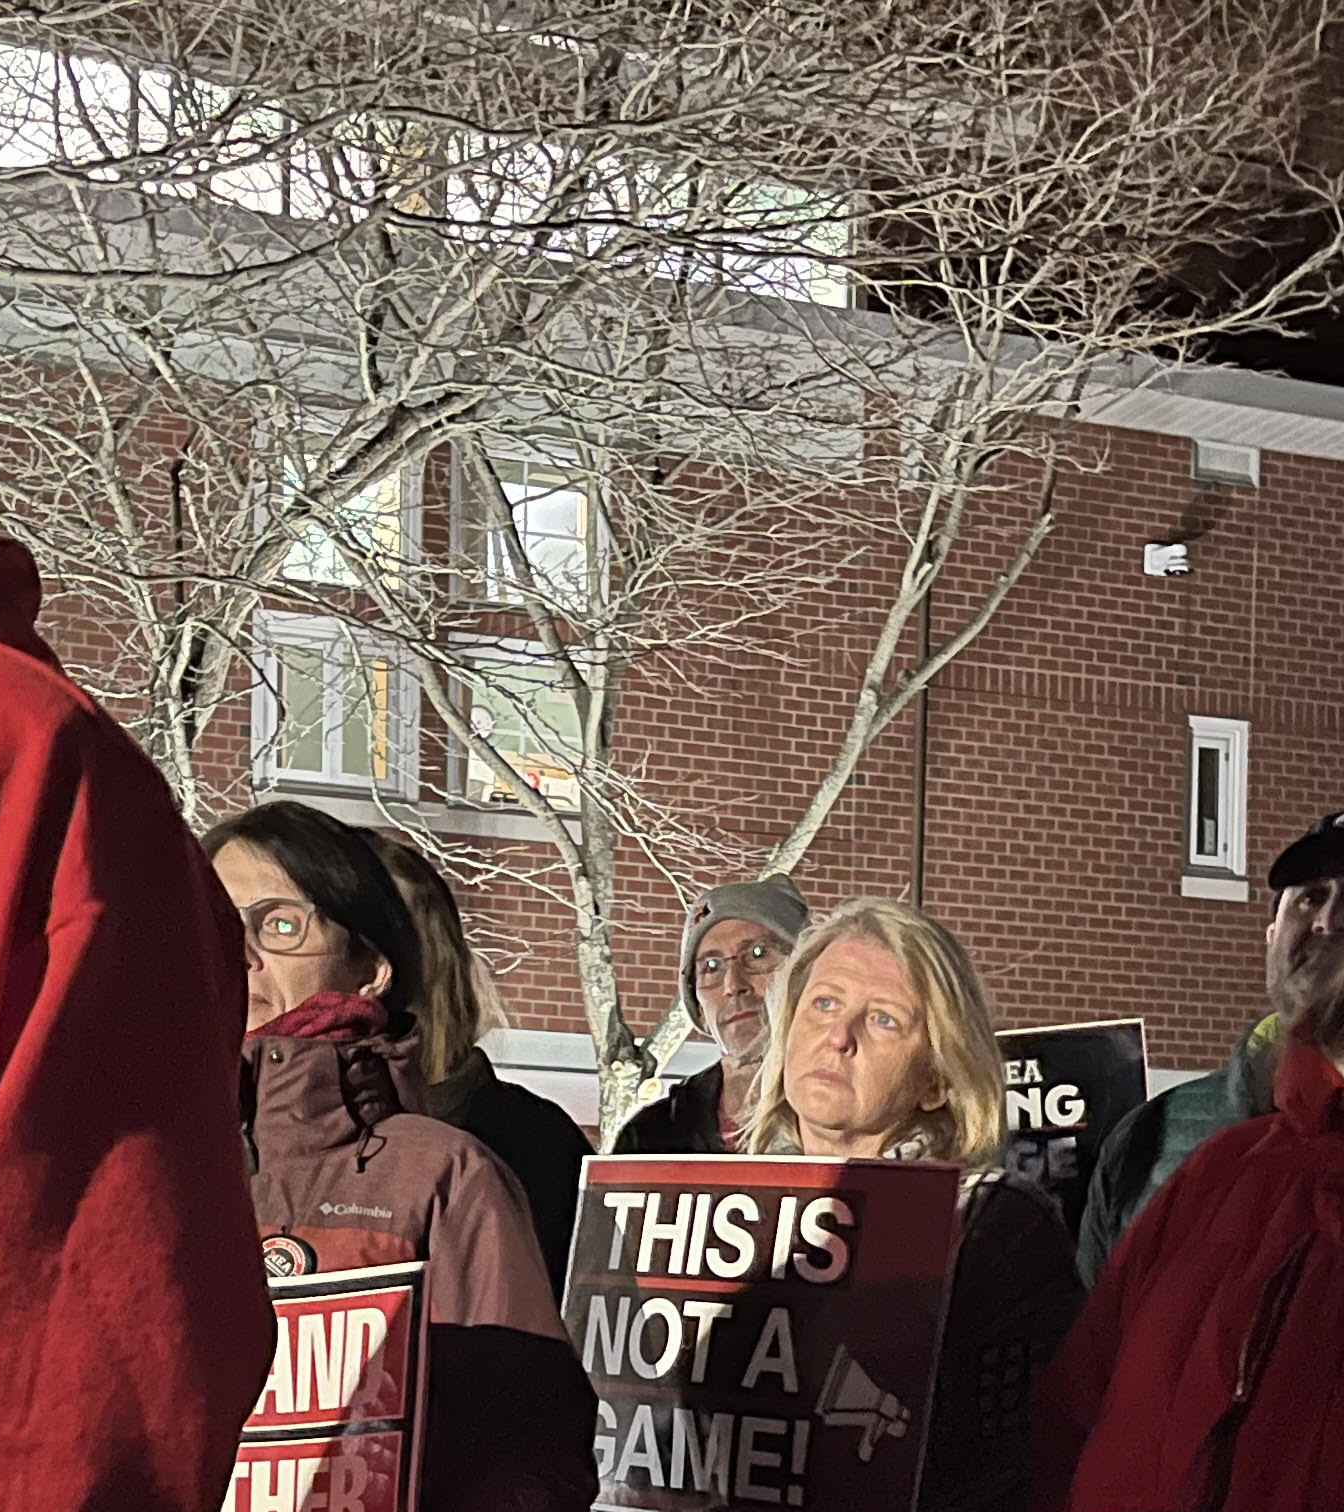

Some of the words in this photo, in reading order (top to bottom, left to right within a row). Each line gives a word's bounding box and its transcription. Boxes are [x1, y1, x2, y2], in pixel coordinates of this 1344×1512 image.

[1002, 1058, 1044, 1086] EA
[1006, 1084, 1085, 1131] NG
[1005, 1136, 1079, 1184] GE
[333, 1202, 393, 1220] Columbia
[603, 1192, 760, 1278] THIS
[771, 1196, 855, 1284] IS
[253, 1307, 388, 1414] AND
[582, 1295, 734, 1384] NOT
[741, 1307, 799, 1393] A
[593, 1400, 811, 1507] GAME!
